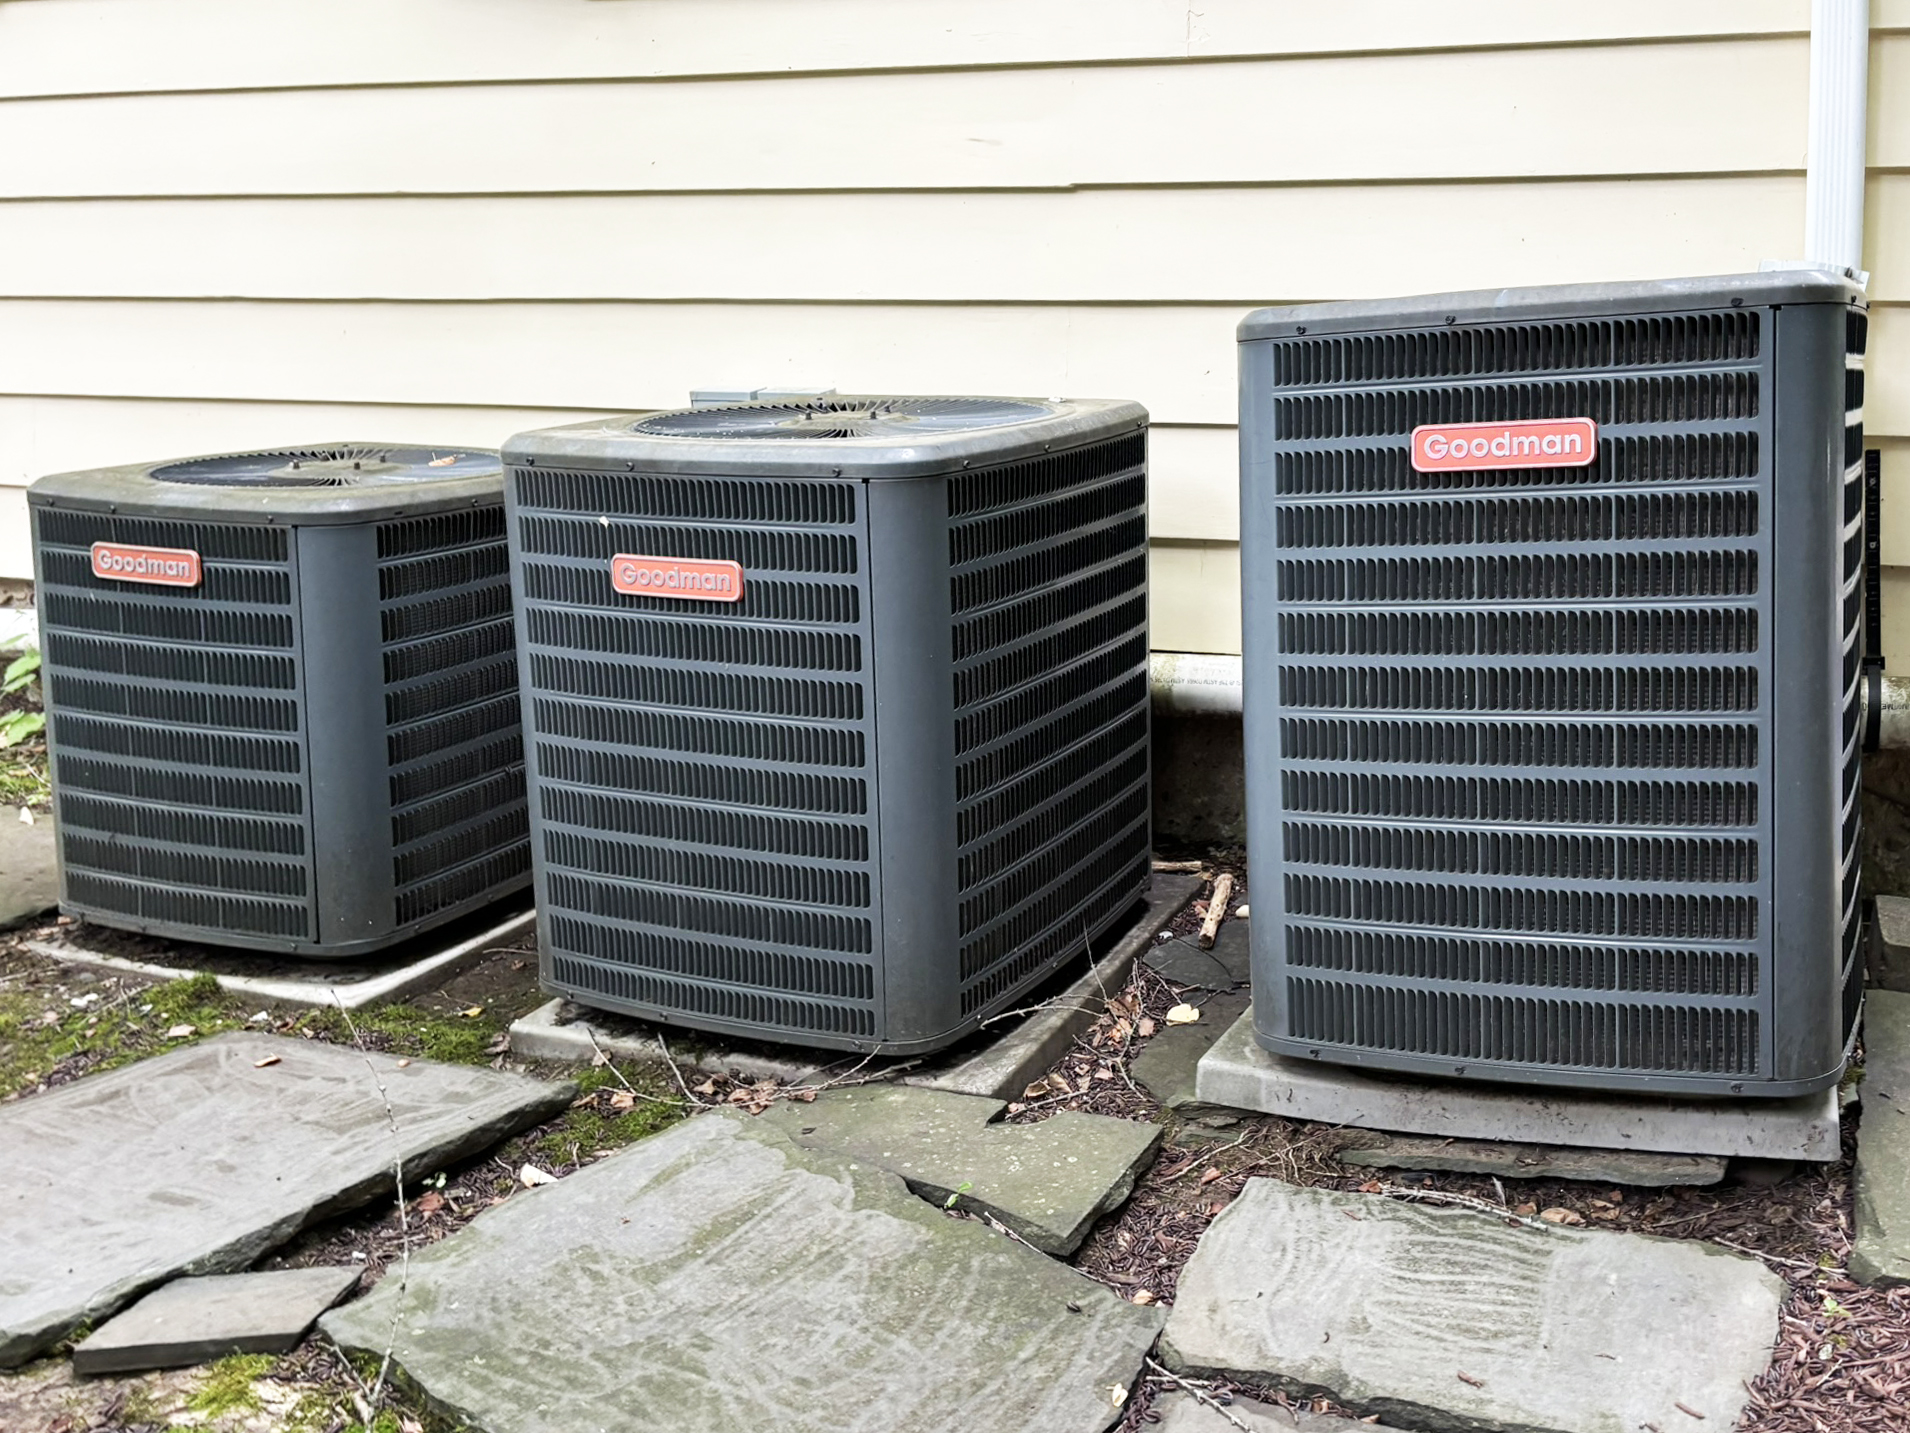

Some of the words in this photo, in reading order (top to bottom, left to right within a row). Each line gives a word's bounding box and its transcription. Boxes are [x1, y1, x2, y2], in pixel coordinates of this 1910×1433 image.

[1424, 431, 1582, 459] Goodman
[98, 549, 190, 577] Goodman
[620, 563, 731, 591] Goodman
